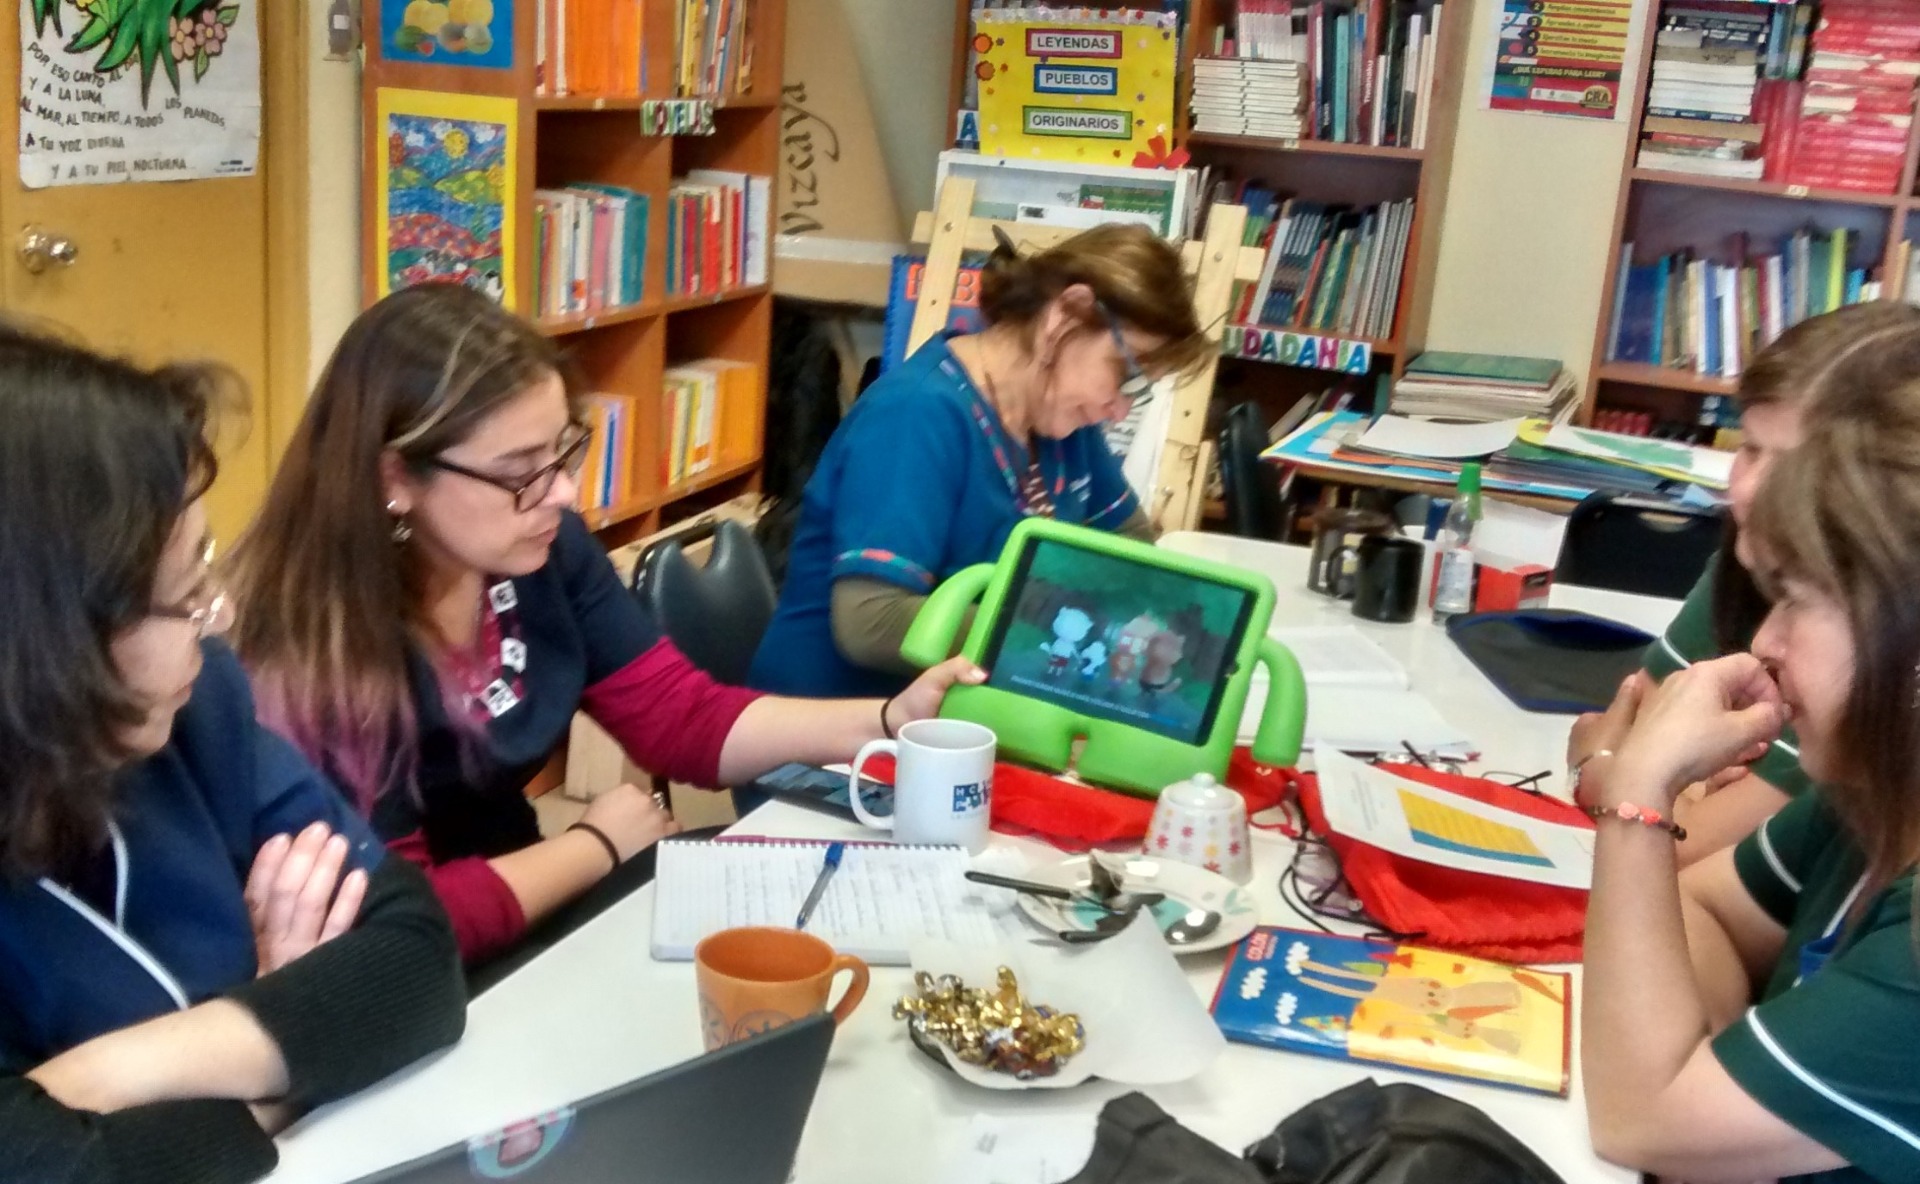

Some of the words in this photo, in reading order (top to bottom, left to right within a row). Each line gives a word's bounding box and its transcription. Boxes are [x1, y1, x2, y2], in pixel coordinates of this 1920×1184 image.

[1036, 35, 1110, 50] LEYENDAS
[27, 41, 50, 66] POR
[51, 63, 70, 82] ESO
[1045, 72, 1109, 87] PUEBLOS
[29, 77, 38, 90] Y
[43, 83, 52, 95] A
[58, 87, 71, 101] LA
[66, 113, 79, 125] AL
[1032, 114, 1119, 130] ORIGINARIOS
[25, 132, 35, 148] A
[39, 136, 54, 150] TU
[51, 164, 59, 179] Y
[68, 165, 77, 178] A
[85, 164, 99, 176] TU
